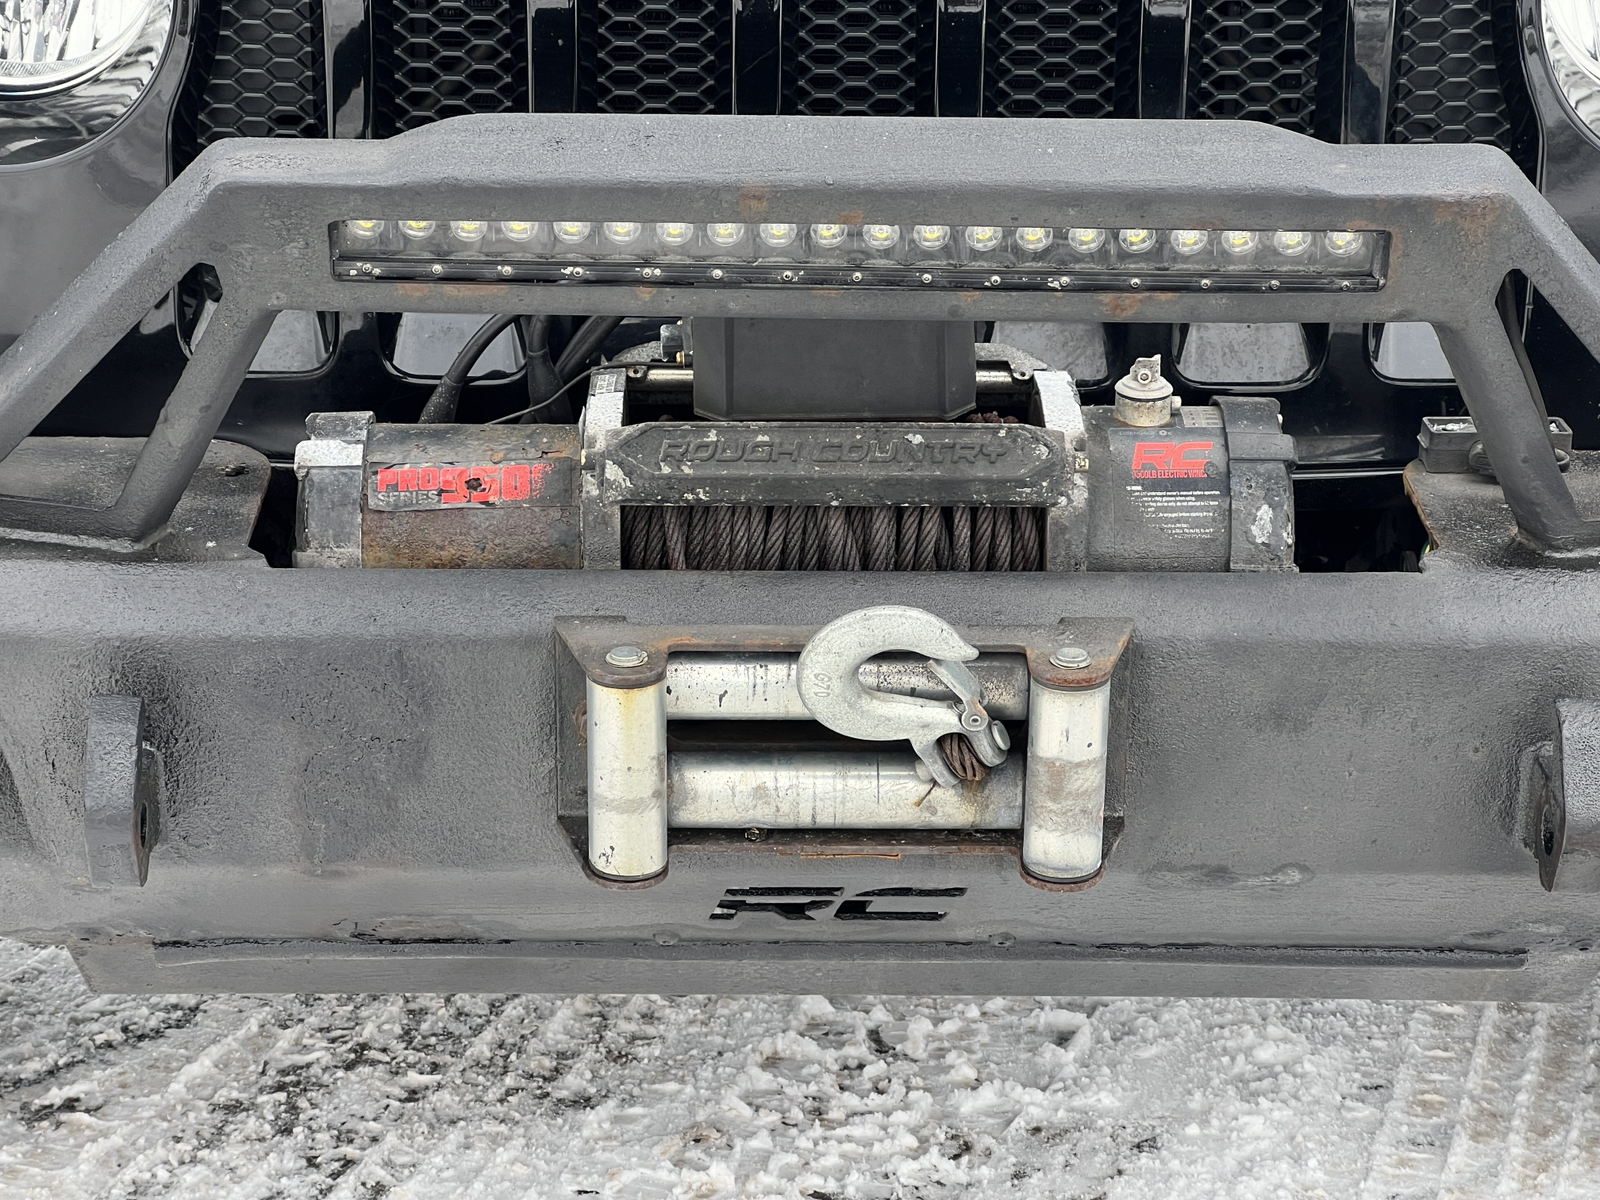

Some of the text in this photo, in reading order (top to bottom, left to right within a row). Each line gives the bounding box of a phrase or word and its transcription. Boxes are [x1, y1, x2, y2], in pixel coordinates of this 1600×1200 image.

[660, 439, 1008, 465] ROUGH COUNTRY
[1132, 442, 1214, 469] RC
[1157, 470, 1187, 478] ELECTRIC
[812, 672, 832, 698] G70
[709, 886, 969, 921] RC
